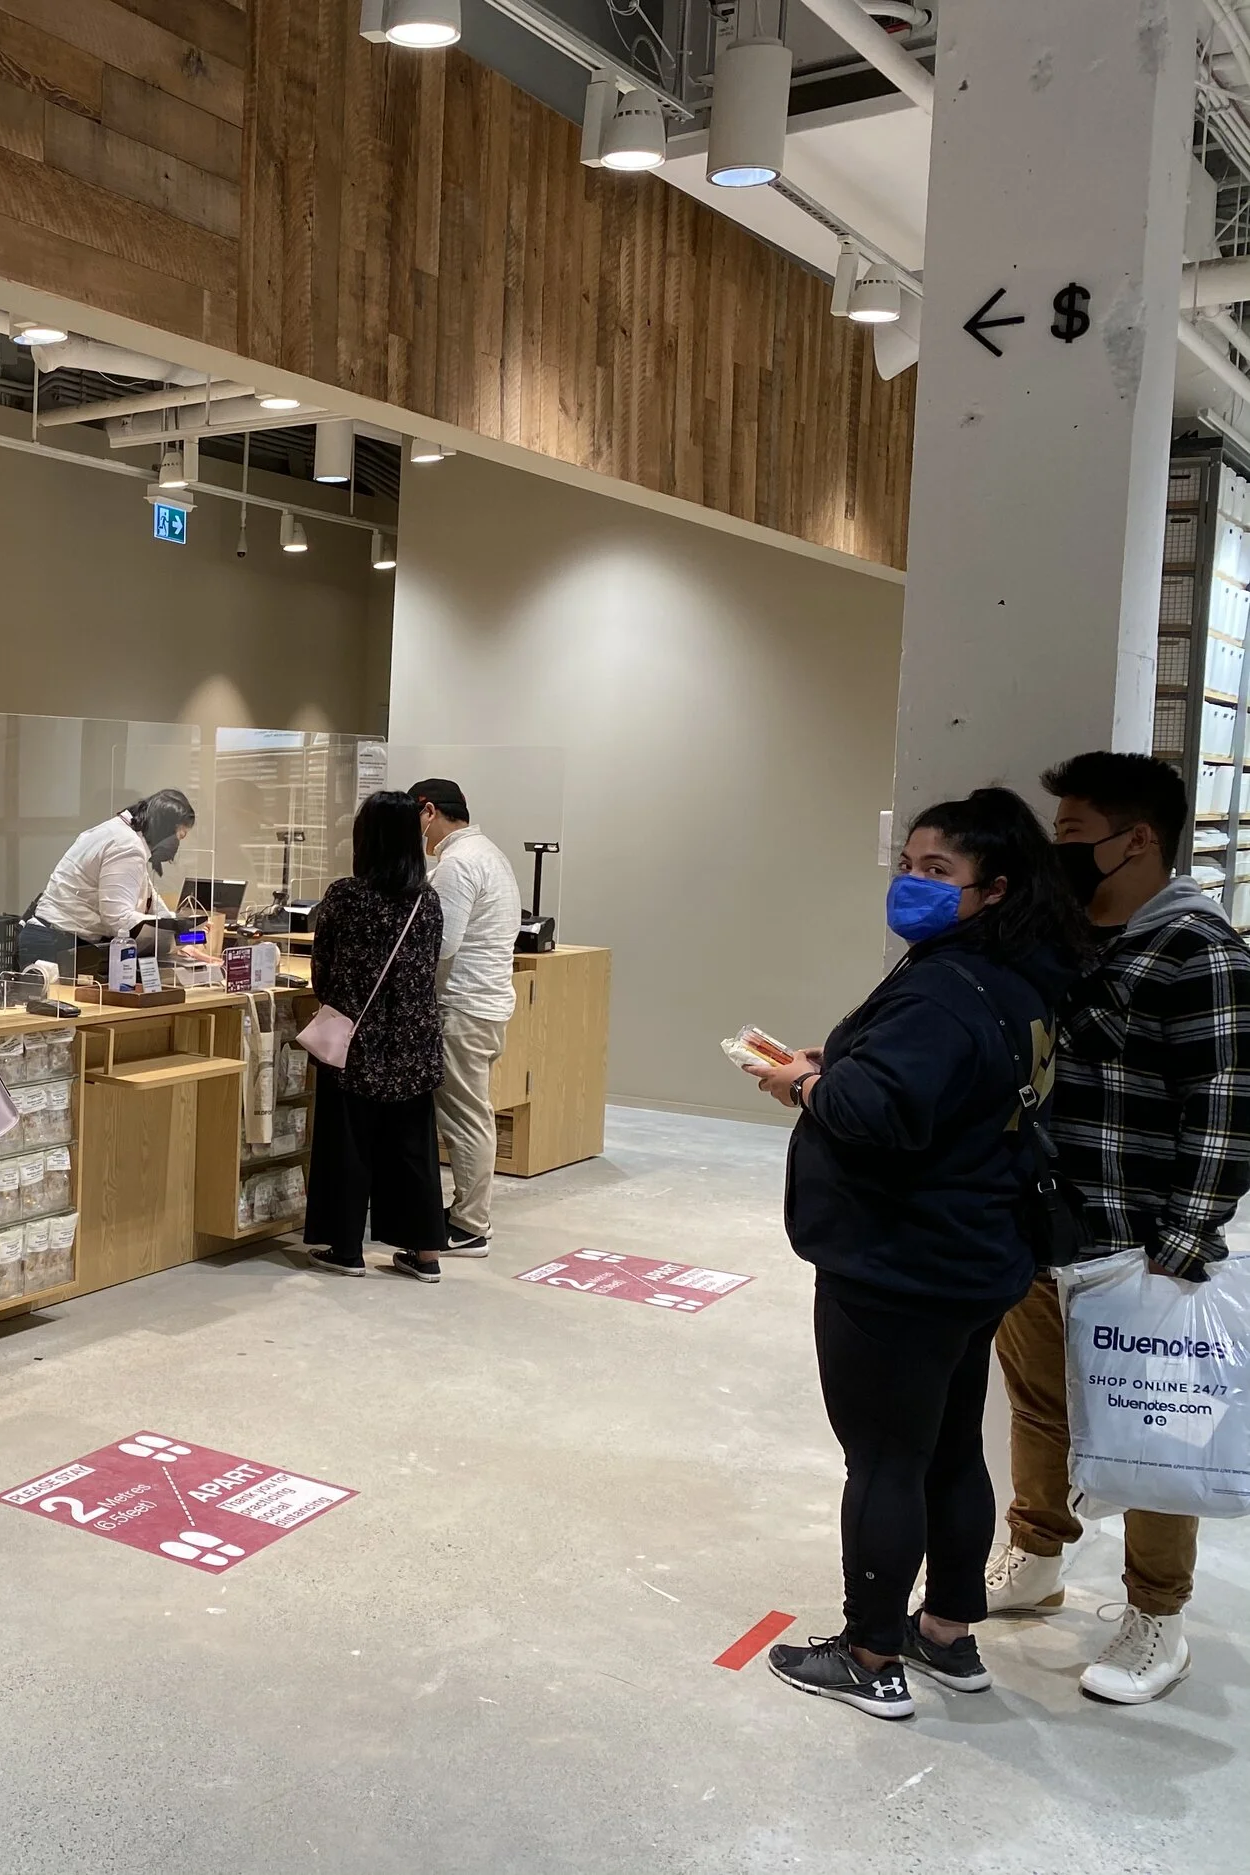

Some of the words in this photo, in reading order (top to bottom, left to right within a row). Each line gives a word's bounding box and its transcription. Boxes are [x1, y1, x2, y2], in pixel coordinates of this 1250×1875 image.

[547, 1277, 596, 1290] 2
[1093, 1325, 1226, 1359] Bluenotes
[1089, 1375, 1127, 1387] SHOP
[1133, 1379, 1188, 1393] ONLINE
[1193, 1384, 1228, 1396] 24/7
[1108, 1394, 1212, 1415] bluenotes.com
[9, 1479, 60, 1502] PLEASE
[55, 1465, 89, 1481] STAY
[187, 1464, 264, 1503] APART
[220, 1491, 256, 1509] Thank
[253, 1478, 278, 1495] you
[270, 1474, 291, 1485] for
[39, 1496, 109, 1523] 2
[100, 1482, 152, 1516] Metres
[240, 1487, 297, 1516] practicing
[257, 1501, 293, 1521] social
[275, 1496, 333, 1527] distancing
